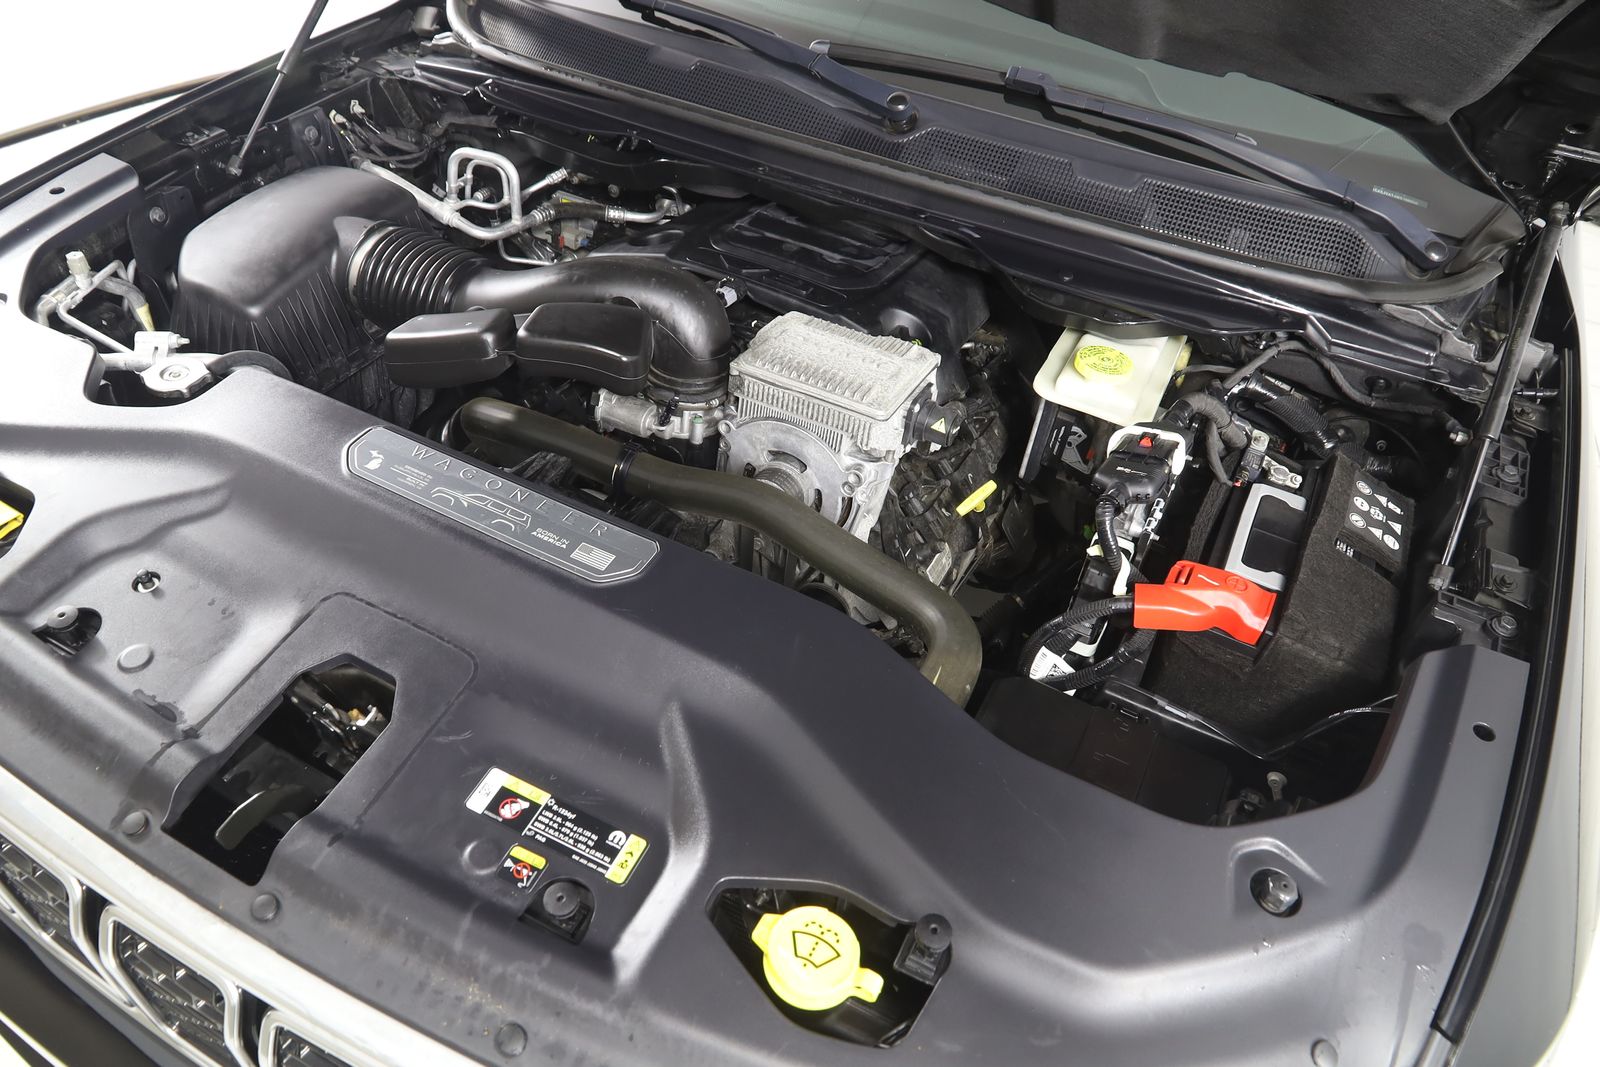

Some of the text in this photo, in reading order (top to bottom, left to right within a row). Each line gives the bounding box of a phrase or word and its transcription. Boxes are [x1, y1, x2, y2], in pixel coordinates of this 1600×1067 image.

[411, 445, 609, 537] WAGONEER
[531, 531, 567, 549] AMERICA
[536, 528, 559, 540] BORN
[552, 805, 576, 819] R-1234yf
[535, 834, 546, 843] PAG
